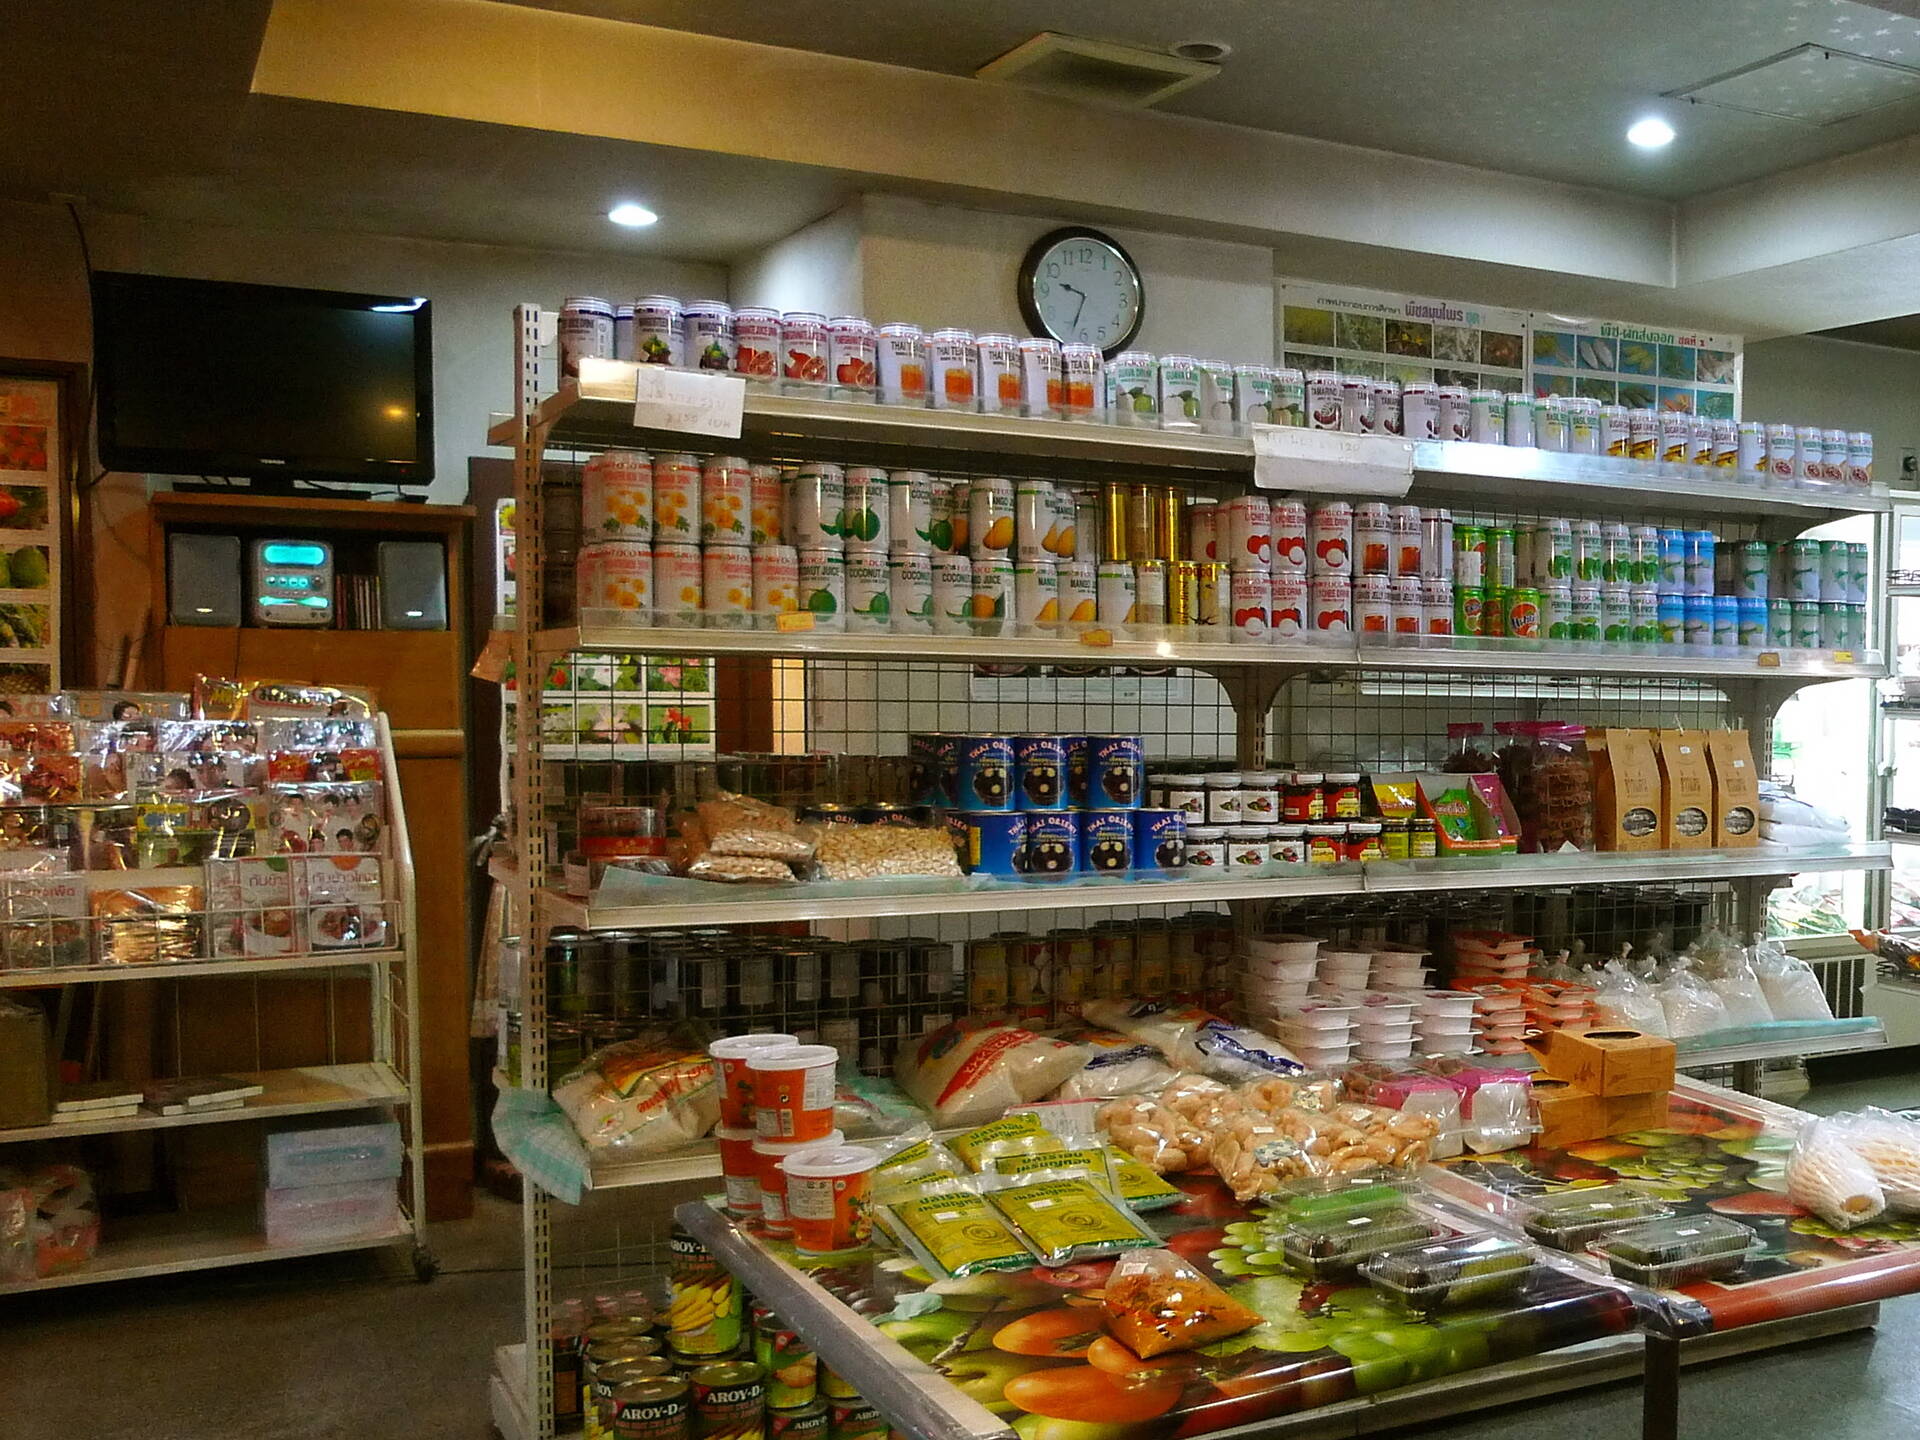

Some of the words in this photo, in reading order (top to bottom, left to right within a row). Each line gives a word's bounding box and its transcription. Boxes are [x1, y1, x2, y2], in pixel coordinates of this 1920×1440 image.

[1063, 250, 1074, 265] 11
[1079, 249, 1093, 264] 12
[1102, 255, 1107, 270] 1
[1047, 263, 1060, 279] 10
[1114, 271, 1123, 286] 2
[1040, 283, 1050, 297] 9
[1119, 293, 1127, 308] 3
[1112, 314, 1120, 328] 4
[1080, 328, 1088, 341] 6
[1097, 327, 1106, 340] 5
[1098, 743, 1118, 758] THAI
[1048, 816, 1077, 834] ORIENT
[1088, 818, 1106, 833] THAI
[1151, 816, 1171, 833] THAI
[707, 1384, 761, 1404] AROY-D
[622, 1403, 678, 1421] AROY-D
